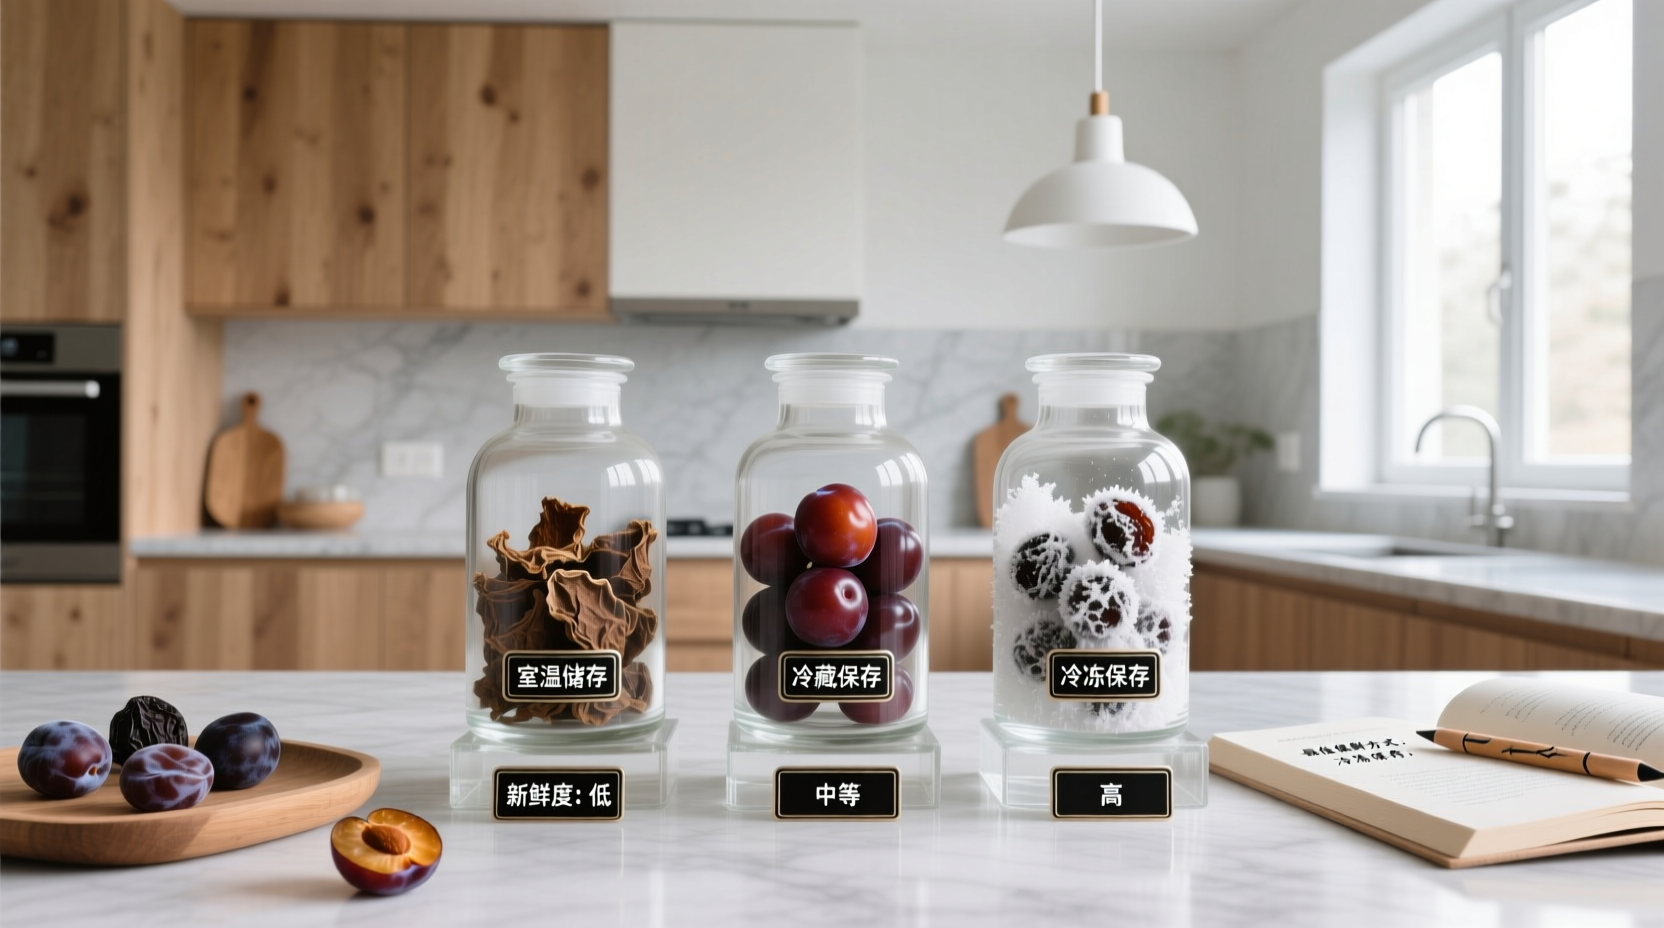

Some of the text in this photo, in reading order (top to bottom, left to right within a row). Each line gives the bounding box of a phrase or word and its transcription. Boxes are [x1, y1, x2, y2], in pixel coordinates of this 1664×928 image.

[517, 662, 607, 690] 室温储存
[792, 662, 882, 690] 冷藏保存
[1060, 662, 1150, 689] 冷冻保存
[816, 782, 861, 807] 中等
[1100, 782, 1123, 807] 高
